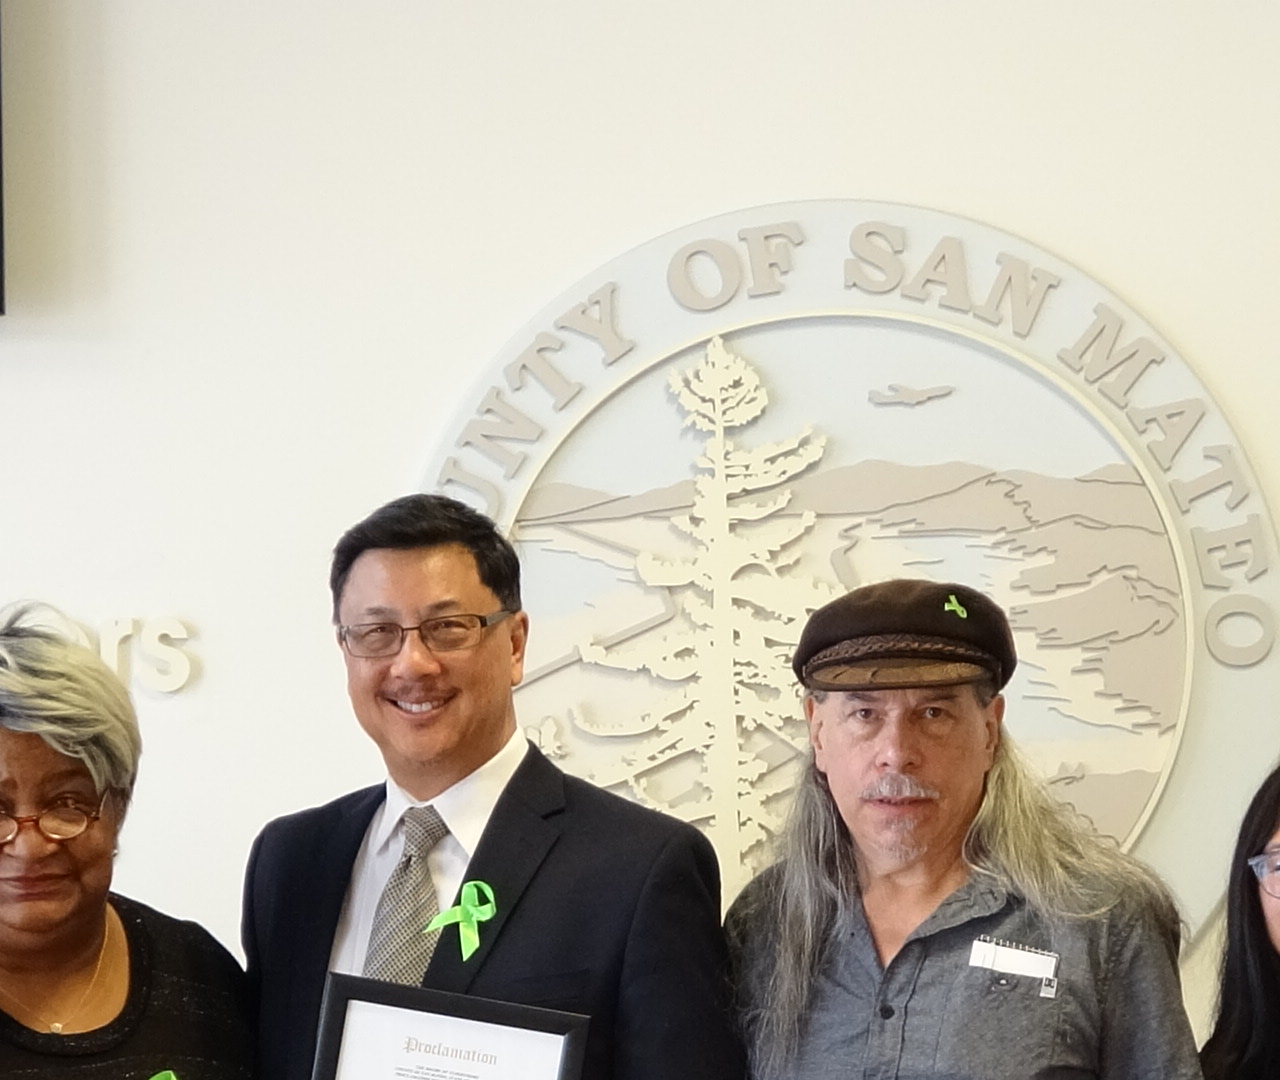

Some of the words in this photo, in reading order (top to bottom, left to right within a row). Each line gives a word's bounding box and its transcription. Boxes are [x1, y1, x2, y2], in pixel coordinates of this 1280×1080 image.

[436, 281, 636, 516] UNTY
[666, 221, 807, 312] OF
[843, 221, 1061, 338] SAN
[1057, 302, 1276, 667] MATEO
[402, 1036, 498, 1066] Proclamation
